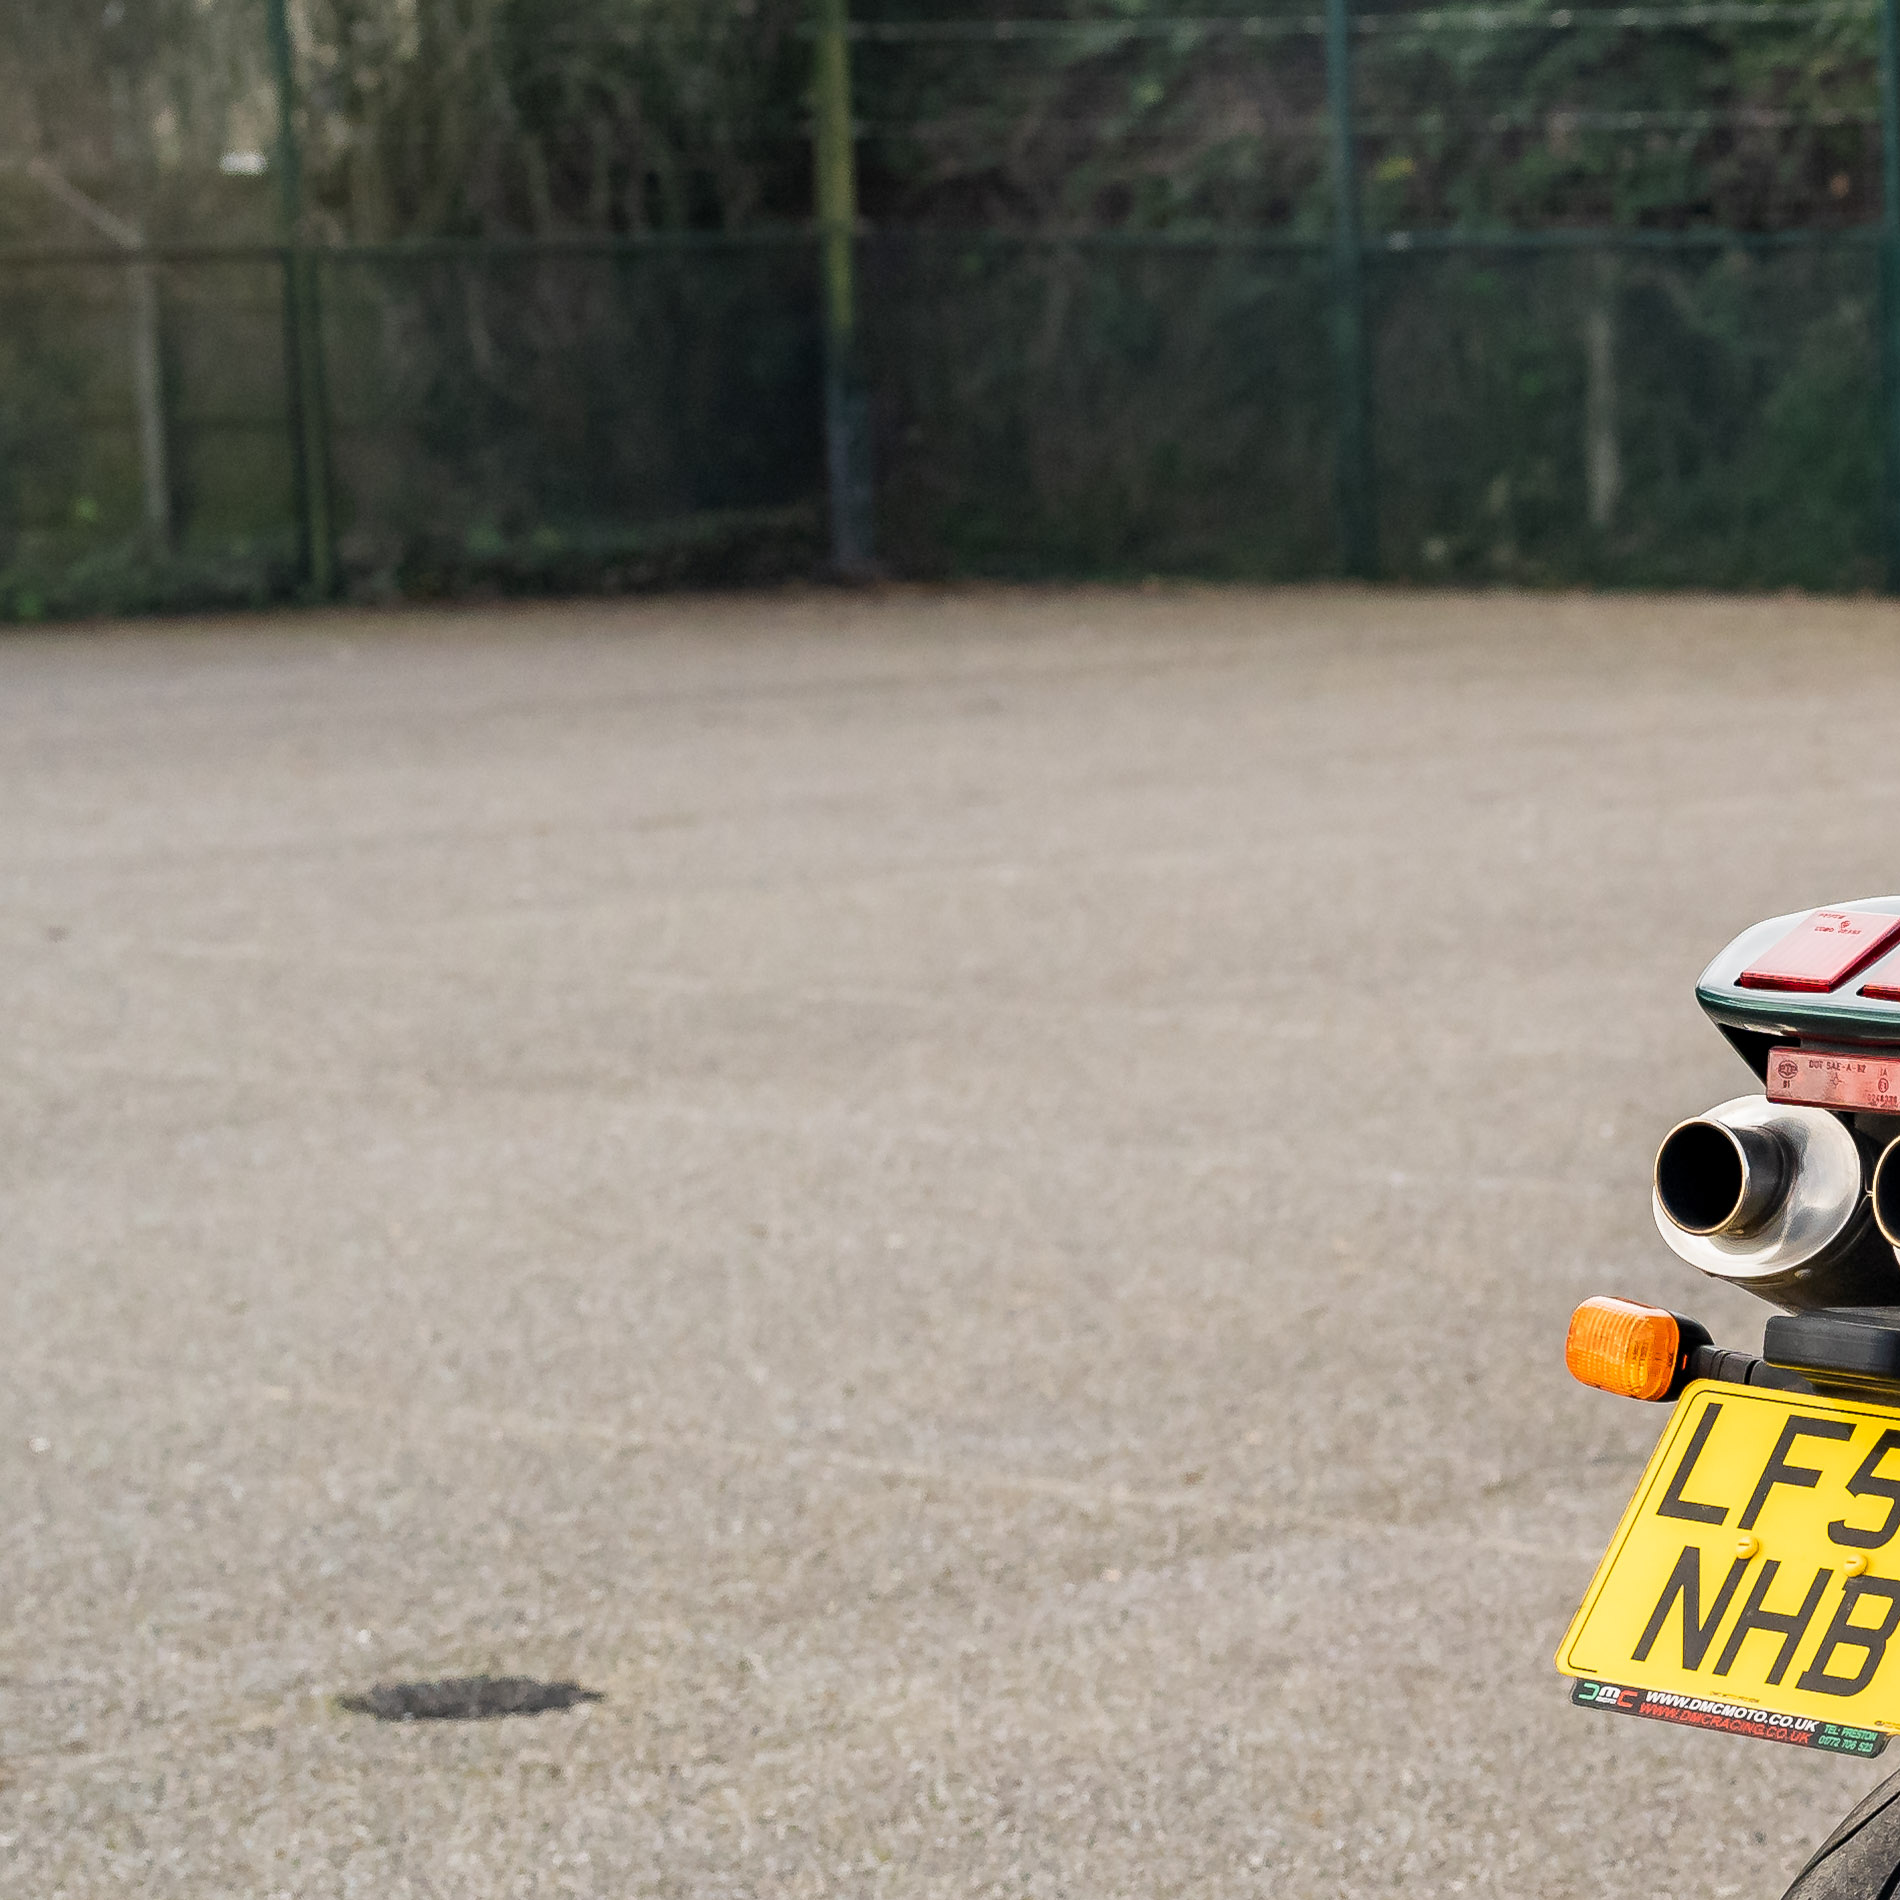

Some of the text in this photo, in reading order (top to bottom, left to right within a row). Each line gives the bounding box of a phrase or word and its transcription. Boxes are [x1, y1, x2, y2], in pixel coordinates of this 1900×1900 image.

[1639, 1703, 1813, 1745] WWW.DMCRACING.CO.UK
[1645, 1691, 1820, 1733] WWW.DMCMOTO.CO.UK
[1841, 1727, 1878, 1741] PRESTON
